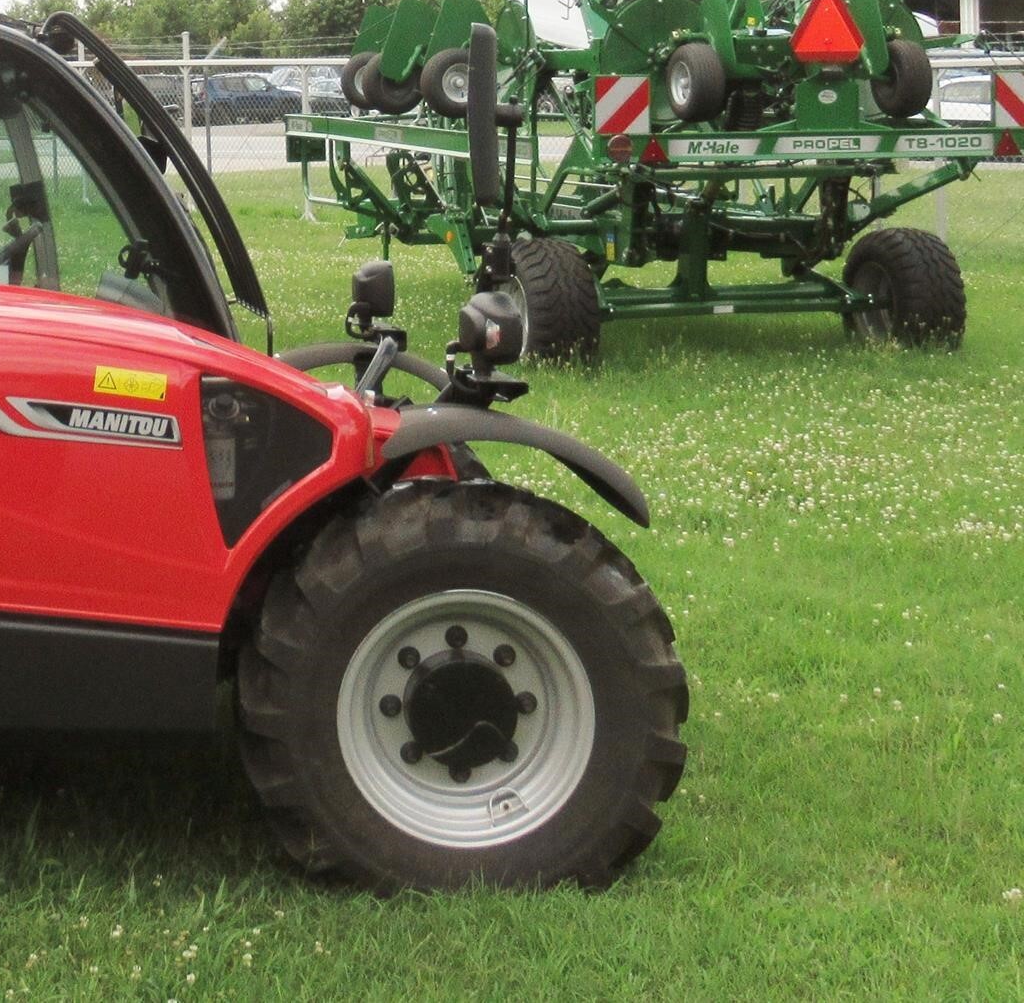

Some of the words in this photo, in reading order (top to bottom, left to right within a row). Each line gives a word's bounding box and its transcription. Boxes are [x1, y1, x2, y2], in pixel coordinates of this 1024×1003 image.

[792, 138, 860, 150] PROPEL
[905, 137, 982, 149] T8-1020
[69, 408, 168, 437] MANITOU
